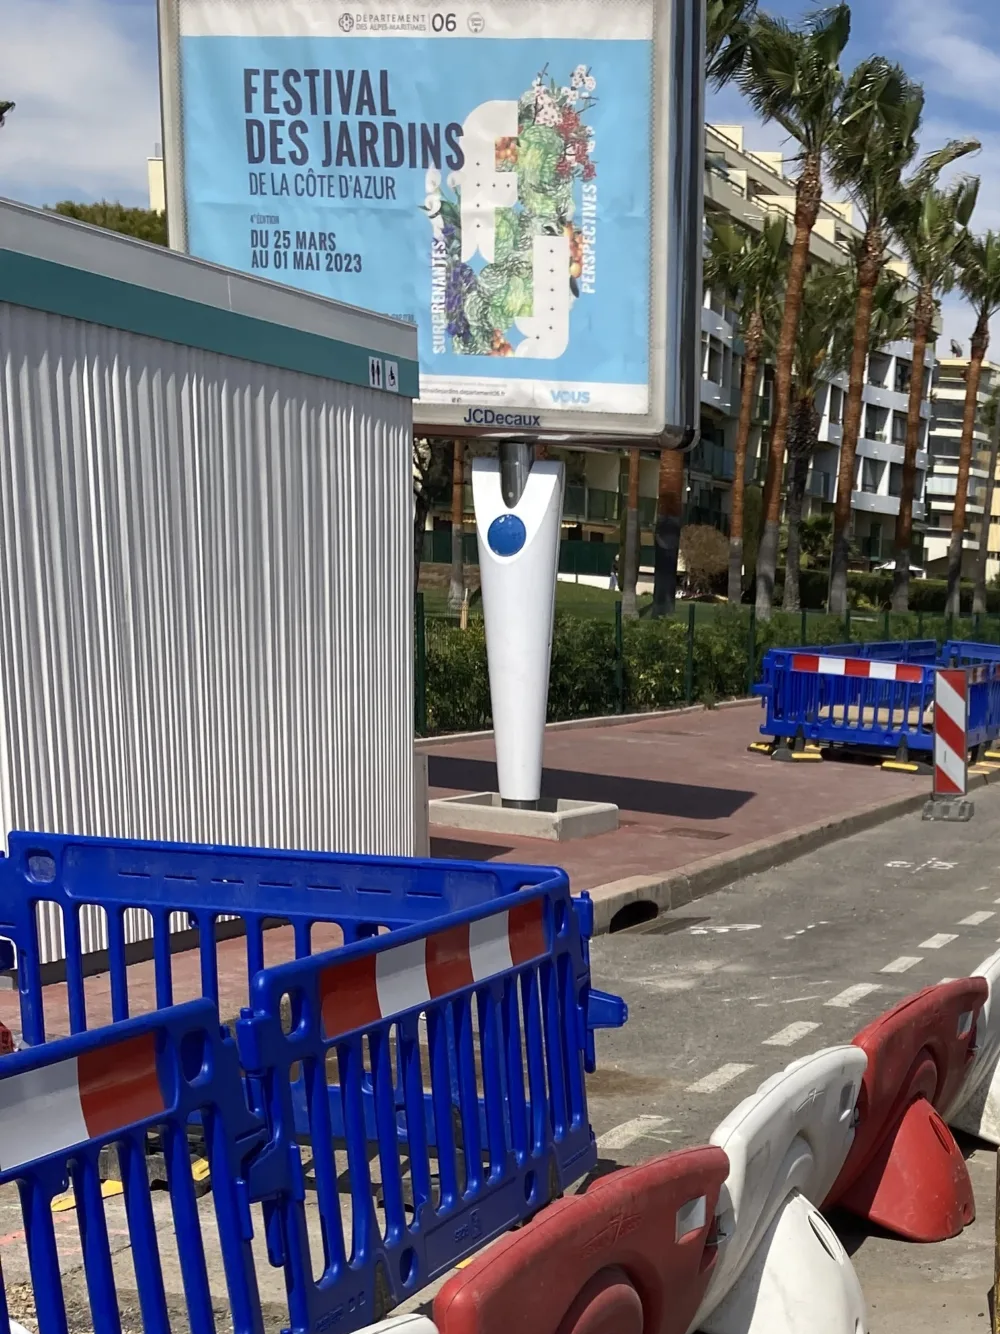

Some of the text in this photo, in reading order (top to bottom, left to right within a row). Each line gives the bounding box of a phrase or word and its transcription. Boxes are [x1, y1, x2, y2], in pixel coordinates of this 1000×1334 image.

[431, 13, 457, 32] 06
[243, 68, 396, 117] FESTIVAL
[245, 118, 465, 171] DES JARDINS
[249, 167, 396, 200] DE LA CÔTE D'AZUR
[250, 229, 337, 251] DU 25 MARS
[581, 184, 597, 294] PERSPECTIVES
[251, 250, 362, 273] AU 01 MAI 2023
[431, 240, 446, 355] SURPRENANTES
[550, 389, 590, 404] VOUS
[463, 408, 541, 427] JCDecaux
